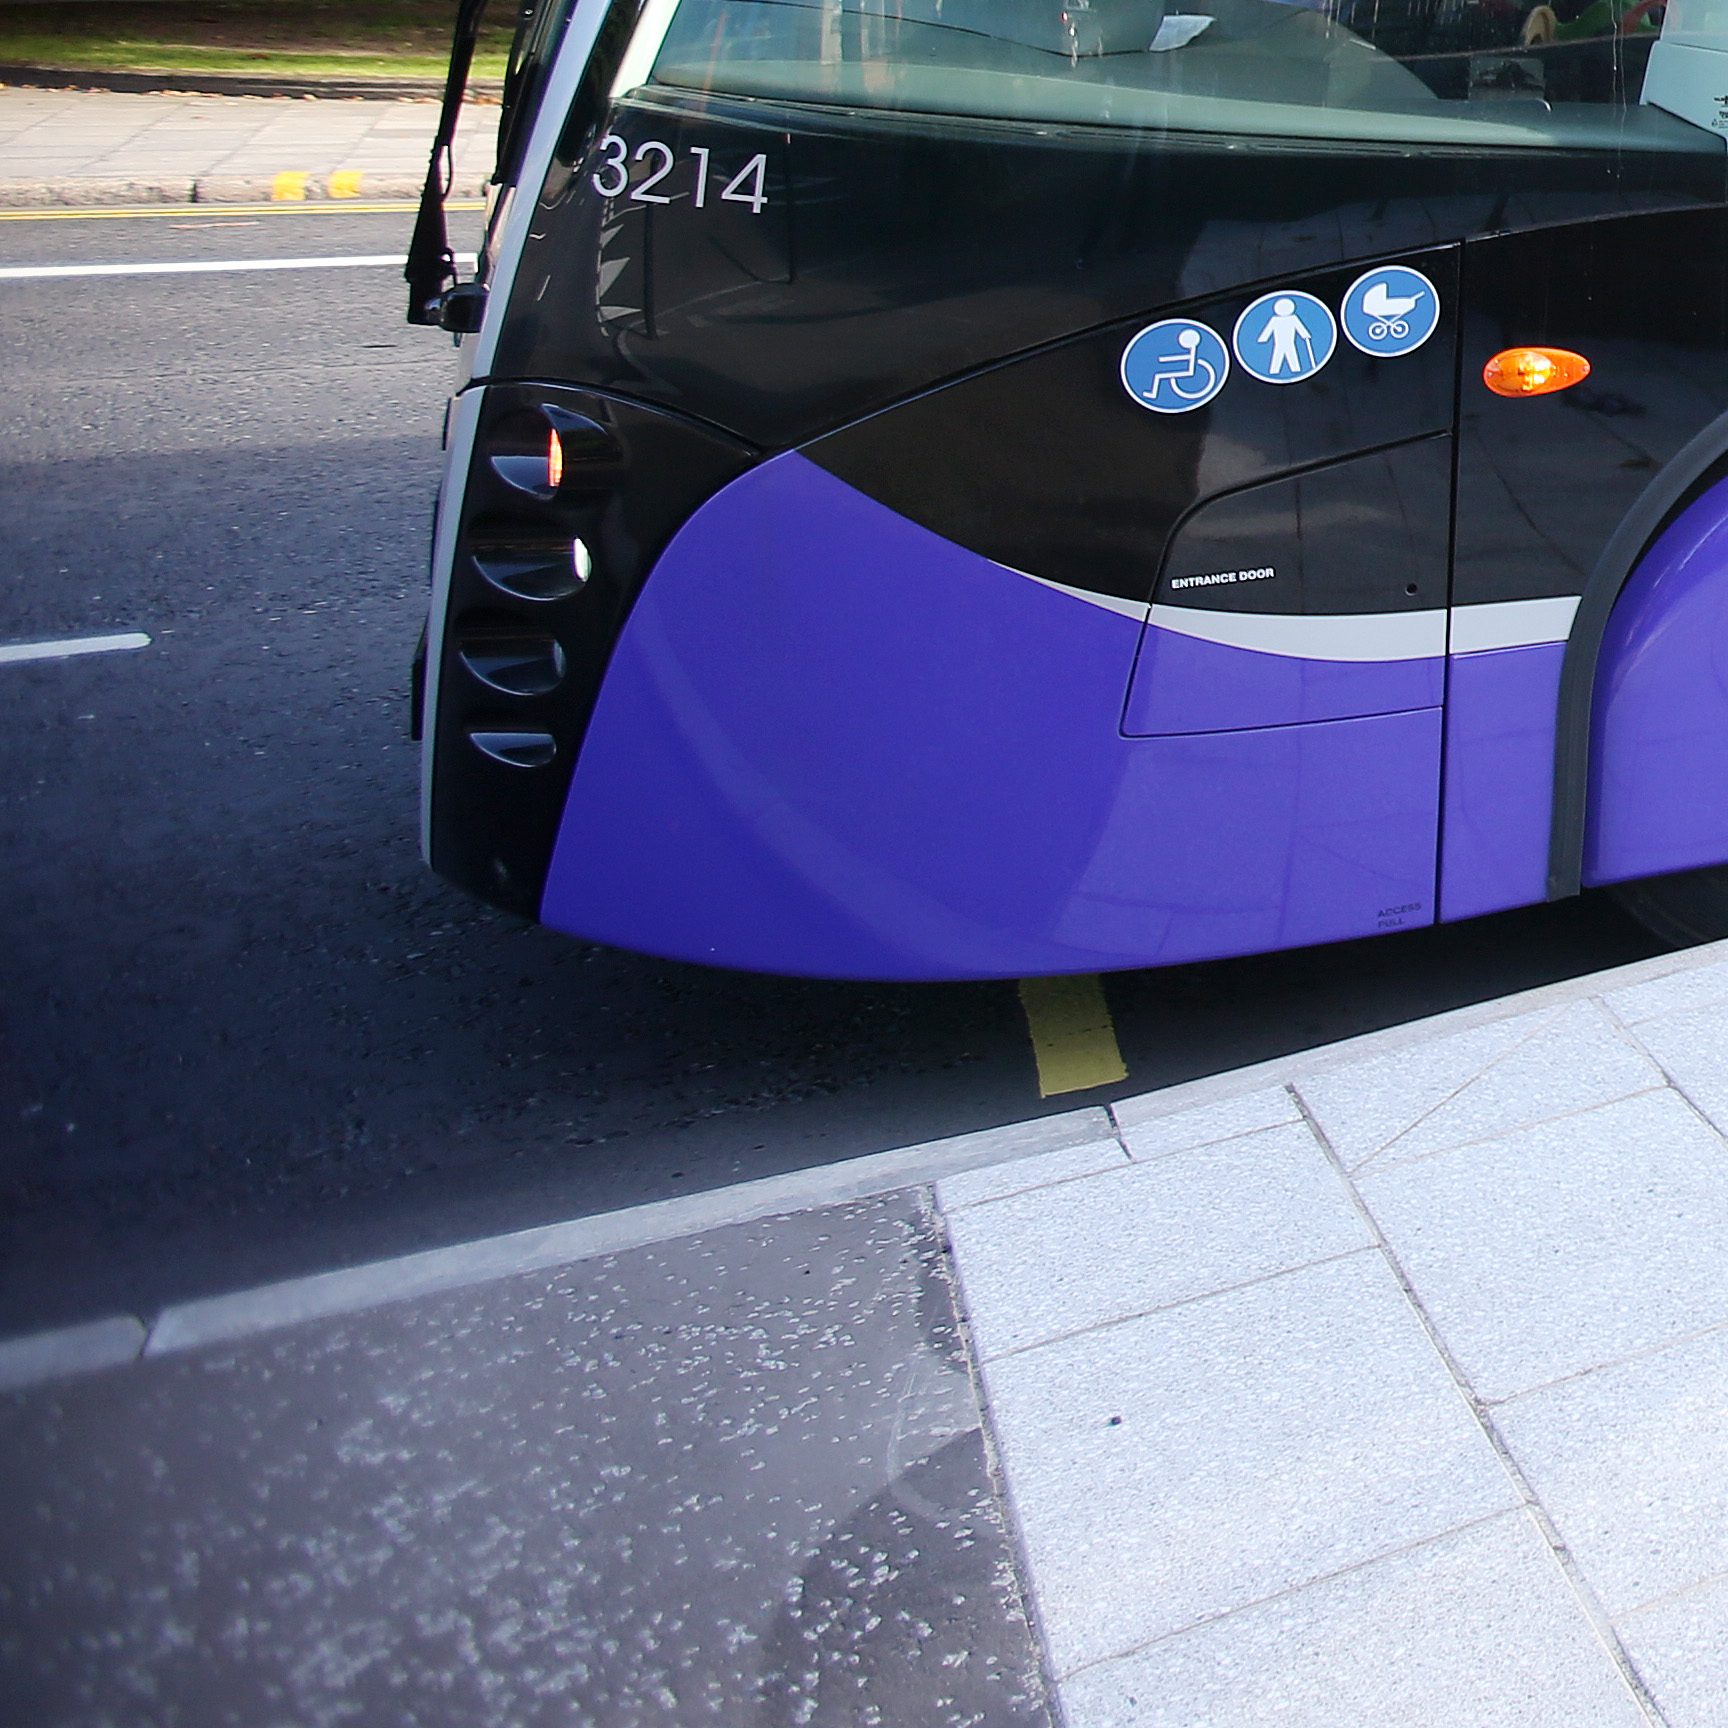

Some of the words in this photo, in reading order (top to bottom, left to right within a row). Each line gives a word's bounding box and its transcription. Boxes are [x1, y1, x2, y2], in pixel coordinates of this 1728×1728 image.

[592, 133, 769, 214] 3214
[1171, 572, 1238, 590] ENTRANCE
[1239, 567, 1275, 582] DOOR
[1377, 902, 1421, 917] ACCESS
